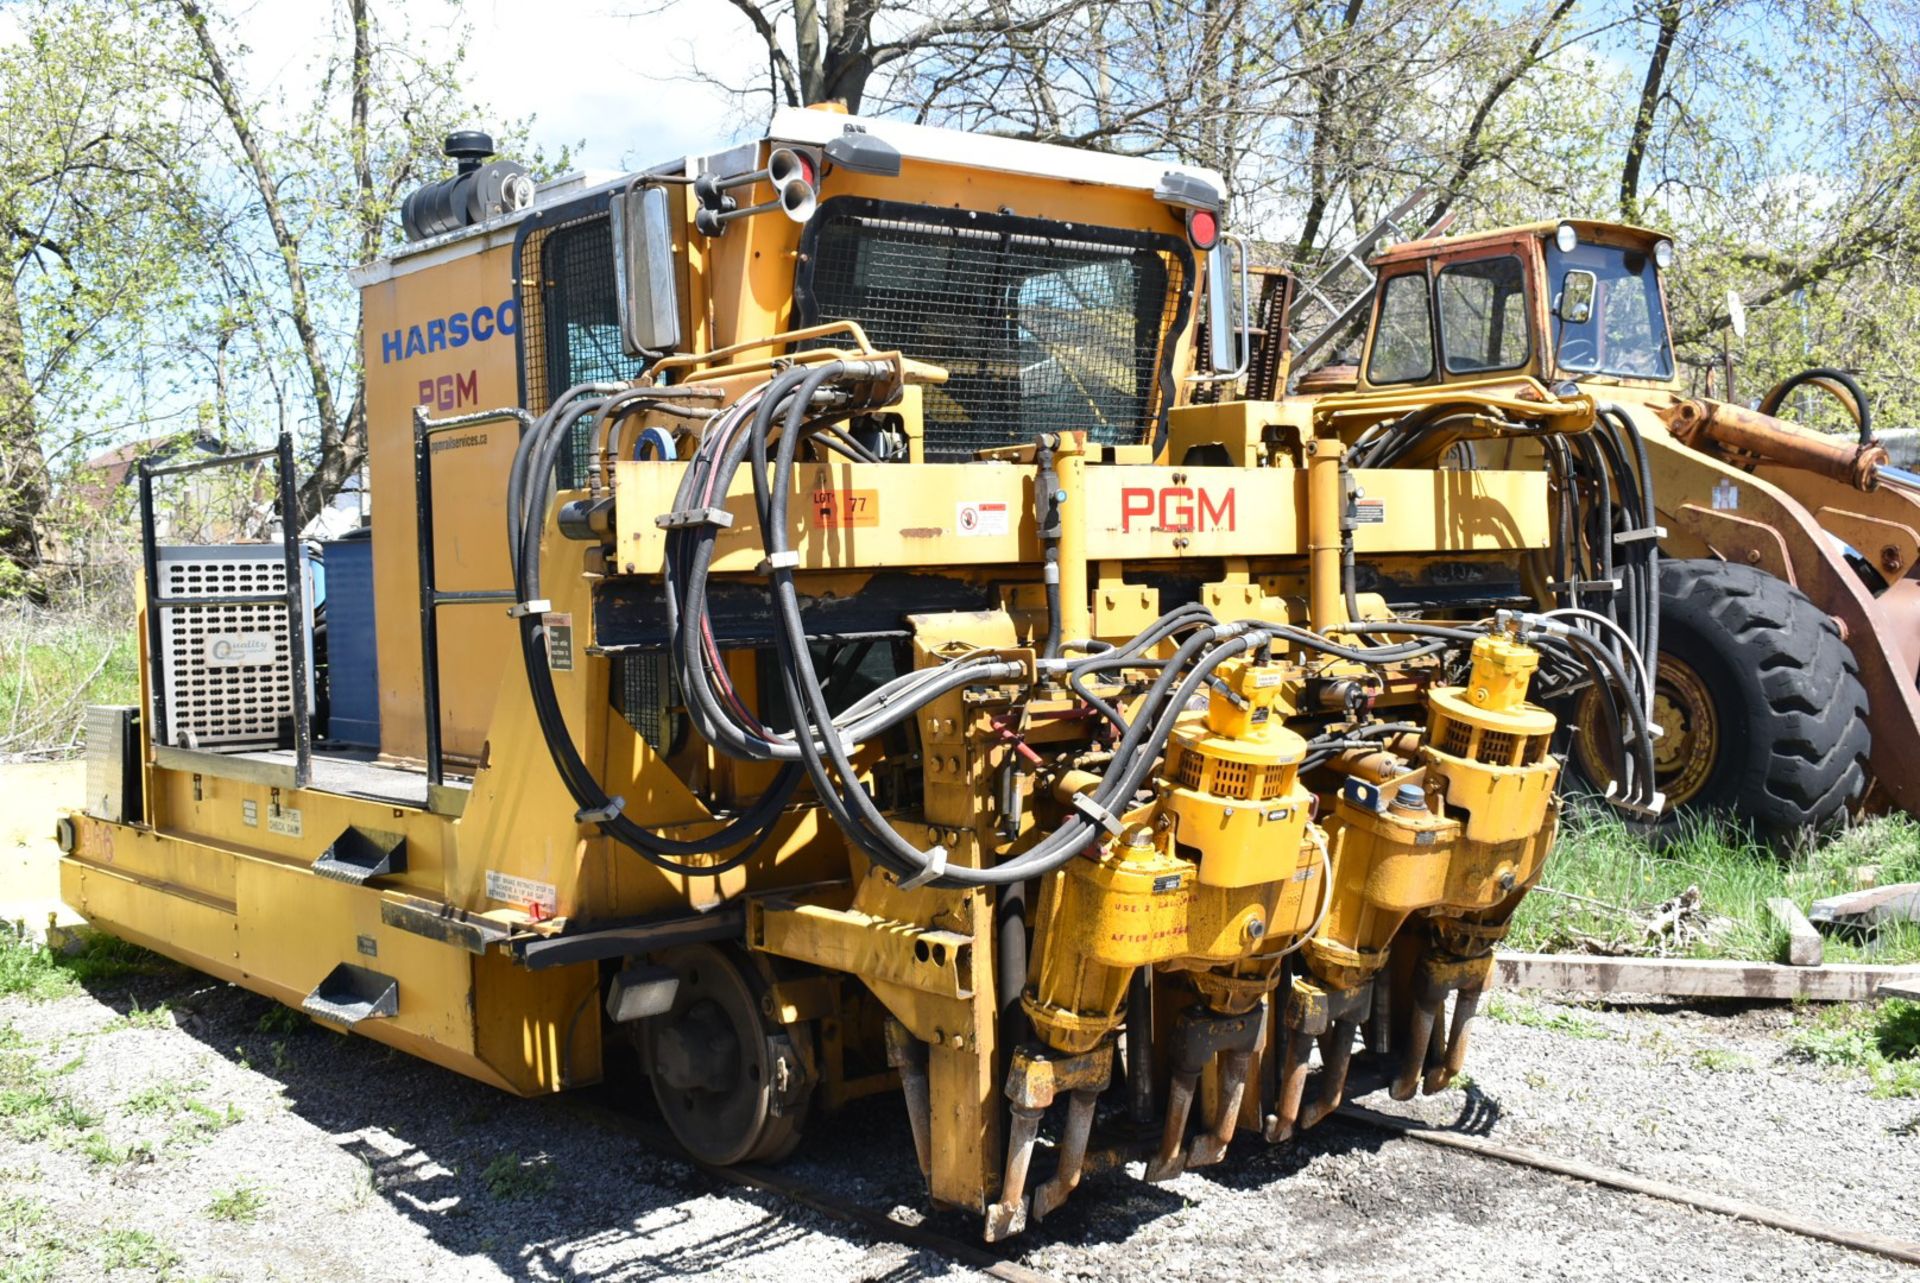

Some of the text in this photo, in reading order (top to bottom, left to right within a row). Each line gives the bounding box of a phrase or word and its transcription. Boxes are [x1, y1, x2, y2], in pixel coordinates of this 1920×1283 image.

[381, 299, 516, 364] HARSCO
[418, 369, 478, 412] PGM
[848, 497, 867, 513] 77
[1121, 487, 1236, 534] PGM
[212, 639, 268, 660] Quality
[1114, 903, 1137, 913] USE
[1110, 932, 1148, 944] AFTER
